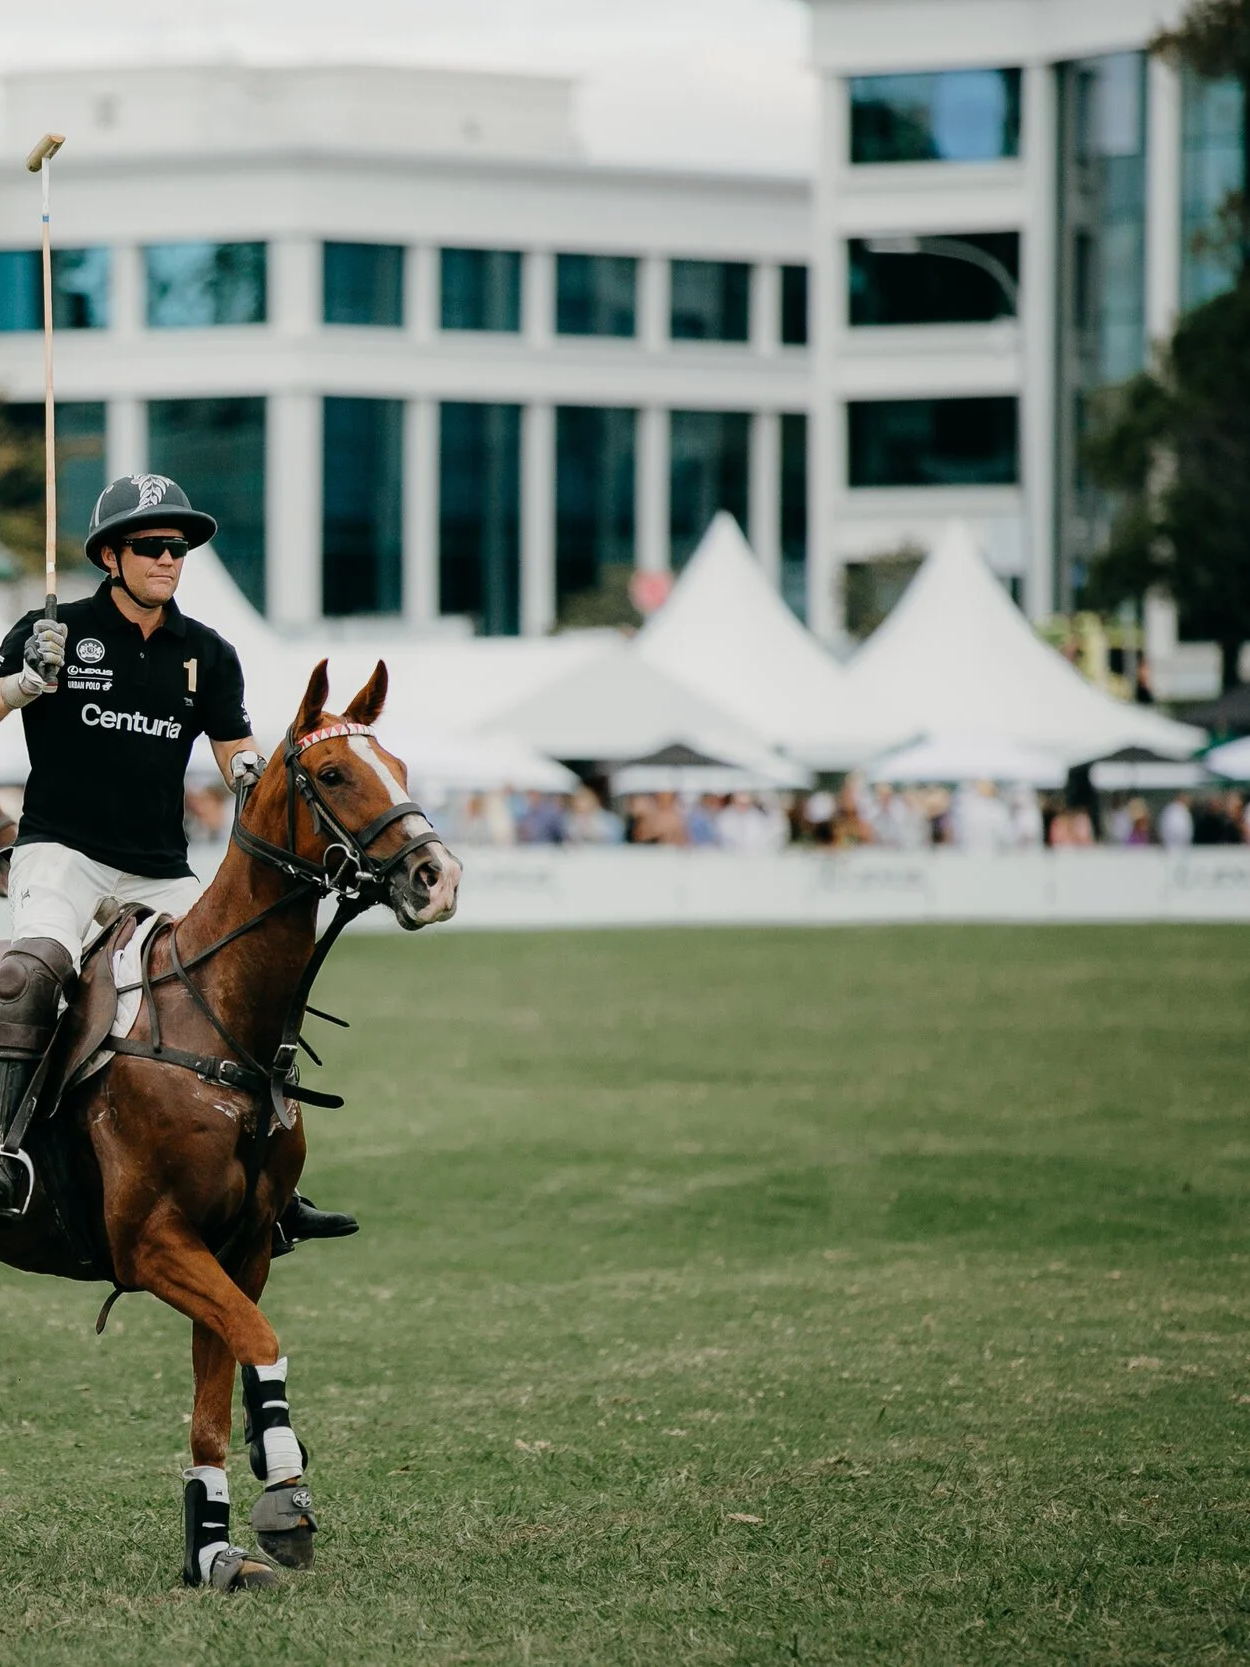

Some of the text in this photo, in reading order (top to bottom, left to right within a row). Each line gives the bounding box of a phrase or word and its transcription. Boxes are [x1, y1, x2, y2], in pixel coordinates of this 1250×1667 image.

[79, 667, 113, 676] LEXUS
[183, 658, 197, 692] 1
[67, 680, 100, 690] URBAN POLO
[81, 703, 182, 739] Centuria
